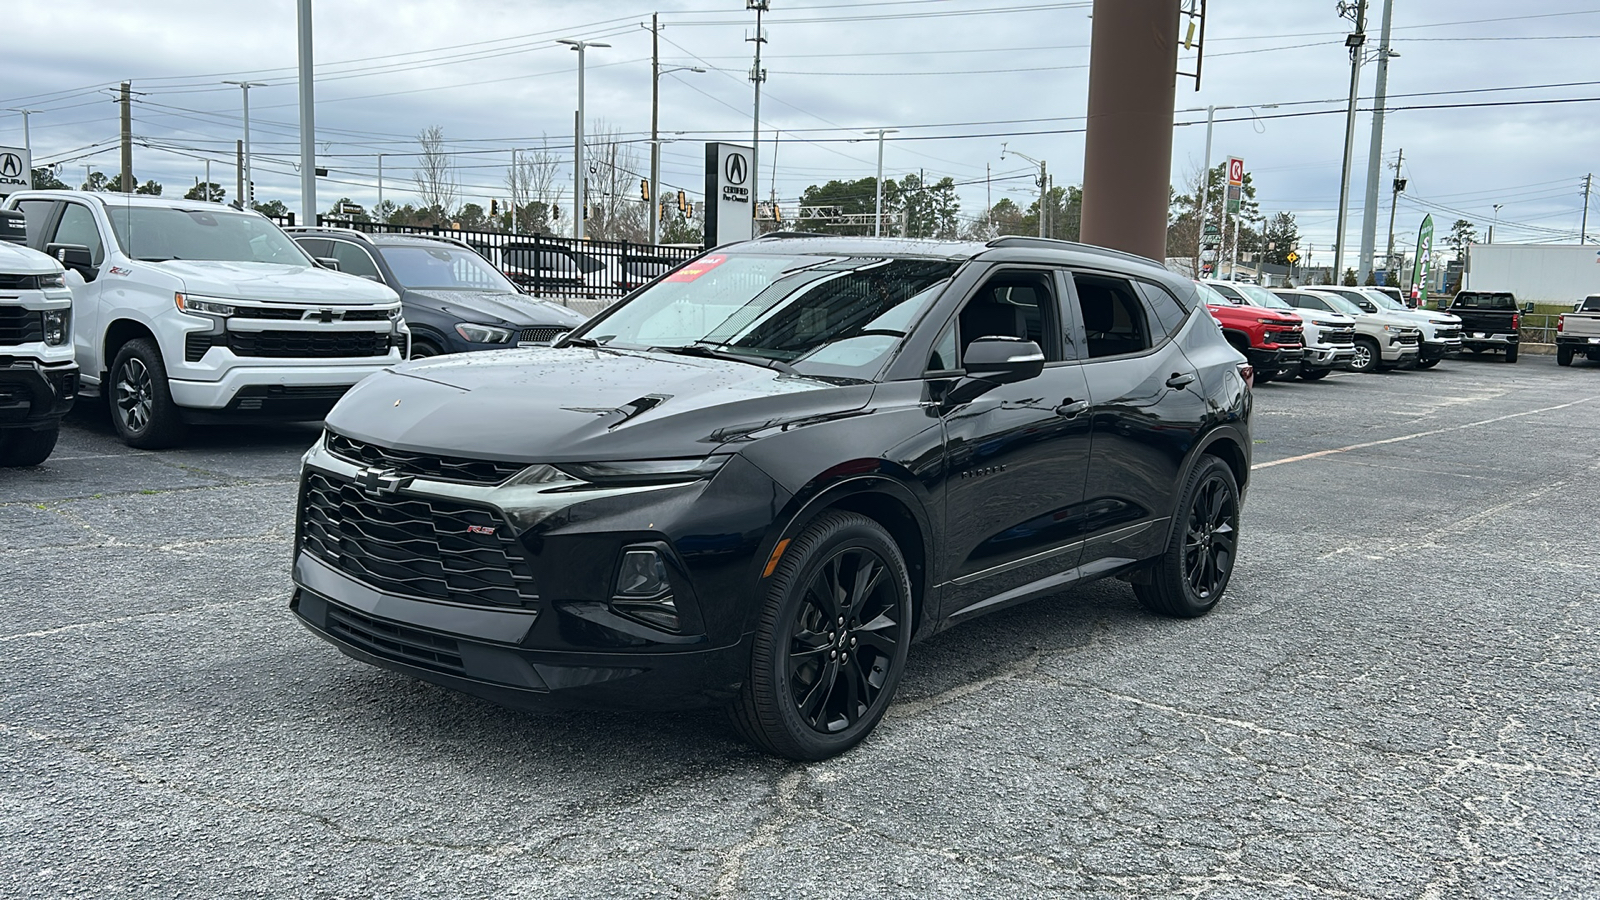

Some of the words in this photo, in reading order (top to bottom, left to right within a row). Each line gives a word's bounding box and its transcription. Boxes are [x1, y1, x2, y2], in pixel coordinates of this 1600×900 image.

[0, 178, 27, 186] CURA
[723, 186, 749, 195] CERTIFIED
[723, 194, 749, 203] Pre-Owned
[1419, 236, 1430, 290] SALE
[467, 525, 495, 535] RS
